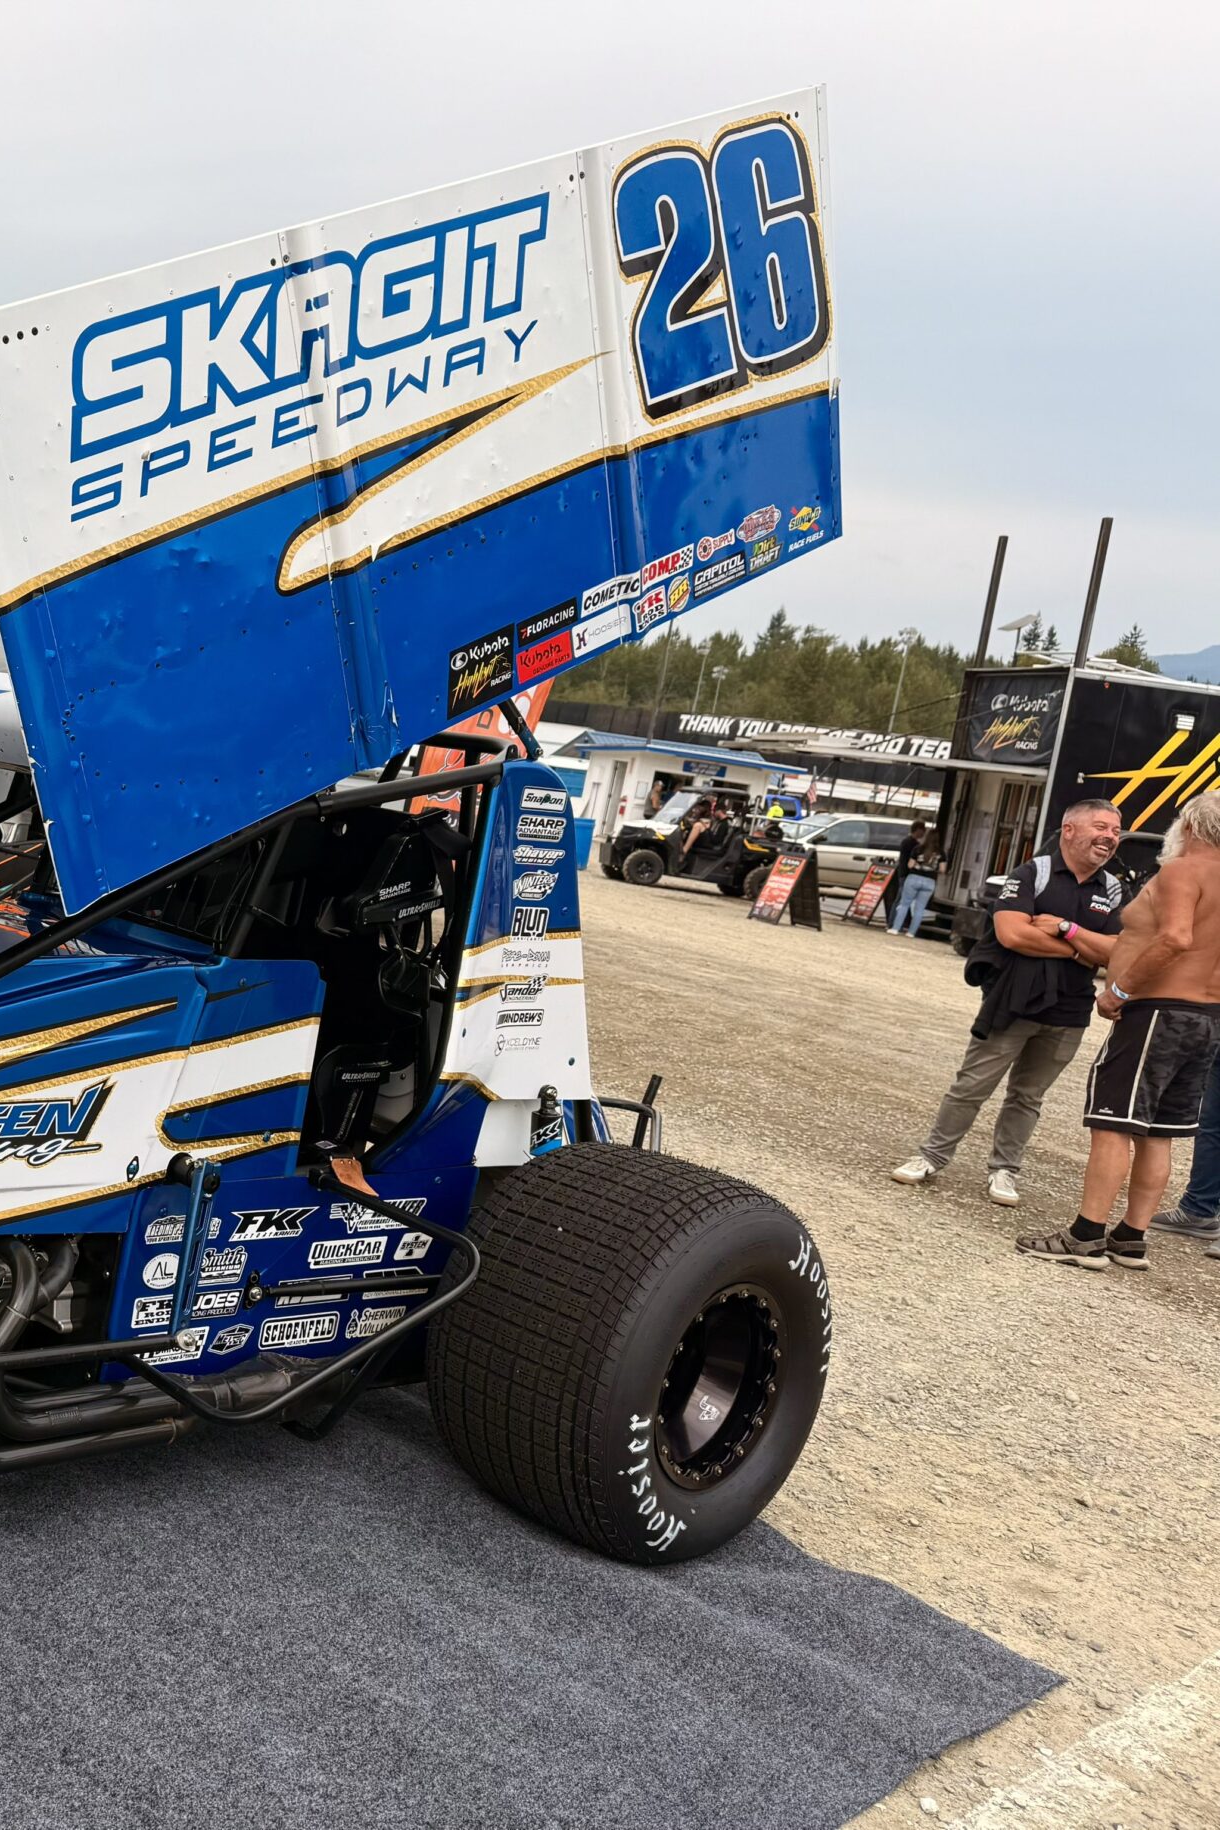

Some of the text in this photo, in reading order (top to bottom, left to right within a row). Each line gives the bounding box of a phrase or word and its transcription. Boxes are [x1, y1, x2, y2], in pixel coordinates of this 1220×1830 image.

[610, 110, 833, 426] 26
[70, 190, 550, 463] SKAGIT
[70, 318, 539, 523] SPEEDWAY
[712, 532, 734, 550] SUPPLY
[788, 529, 824, 553] RACE FUELS
[749, 545, 781, 571] DRAFT
[642, 552, 681, 586] COMP
[668, 561, 690, 575] CAMS
[694, 553, 745, 586] CAPITOL
[583, 577, 640, 611] COMETIC
[640, 591, 663, 614] FK
[526, 605, 575, 638] FLORACING
[643, 604, 664, 621] ROD
[587, 615, 629, 638] HOOSIER
[469, 634, 510, 660] Kubota
[519, 642, 562, 668] Kubota
[554, 653, 571, 667] PARTS
[490, 671, 512, 688] RACING
[1009, 694, 1050, 712] Kubota
[678, 713, 734, 736] THANK
[736, 718, 775, 737] YOU
[859, 733, 905, 755] AND
[907, 739, 953, 760] TEA
[1014, 740, 1039, 750] RACING
[518, 827, 563, 836] ADVANTAGE
[519, 816, 565, 830] SHARP
[515, 845, 564, 859] Shaver
[379, 881, 412, 897] SHARP
[1090, 901, 1111, 913] FORD
[501, 1012, 543, 1024] ANDREWS
[230, 1206, 321, 1236] FK
[232, 1229, 301, 1240] FACTORY KAHNE
[400, 1238, 428, 1250] SYSTEM
[202, 1246, 244, 1269] Smith
[319, 1255, 379, 1265] RACING PRODUCTS
[152, 1261, 174, 1278] AL
[203, 1263, 242, 1272] TITANIUM
[192, 1292, 240, 1311] JOES
[788, 1234, 831, 1375] Hoosier
[191, 1306, 236, 1318] ACING PRODUCTS
[361, 1306, 404, 1322] SHERWIN
[264, 1317, 336, 1343] SCHOENFELD
[358, 1319, 395, 1336] WILLIA
[618, 1413, 689, 1552] Hoosier
